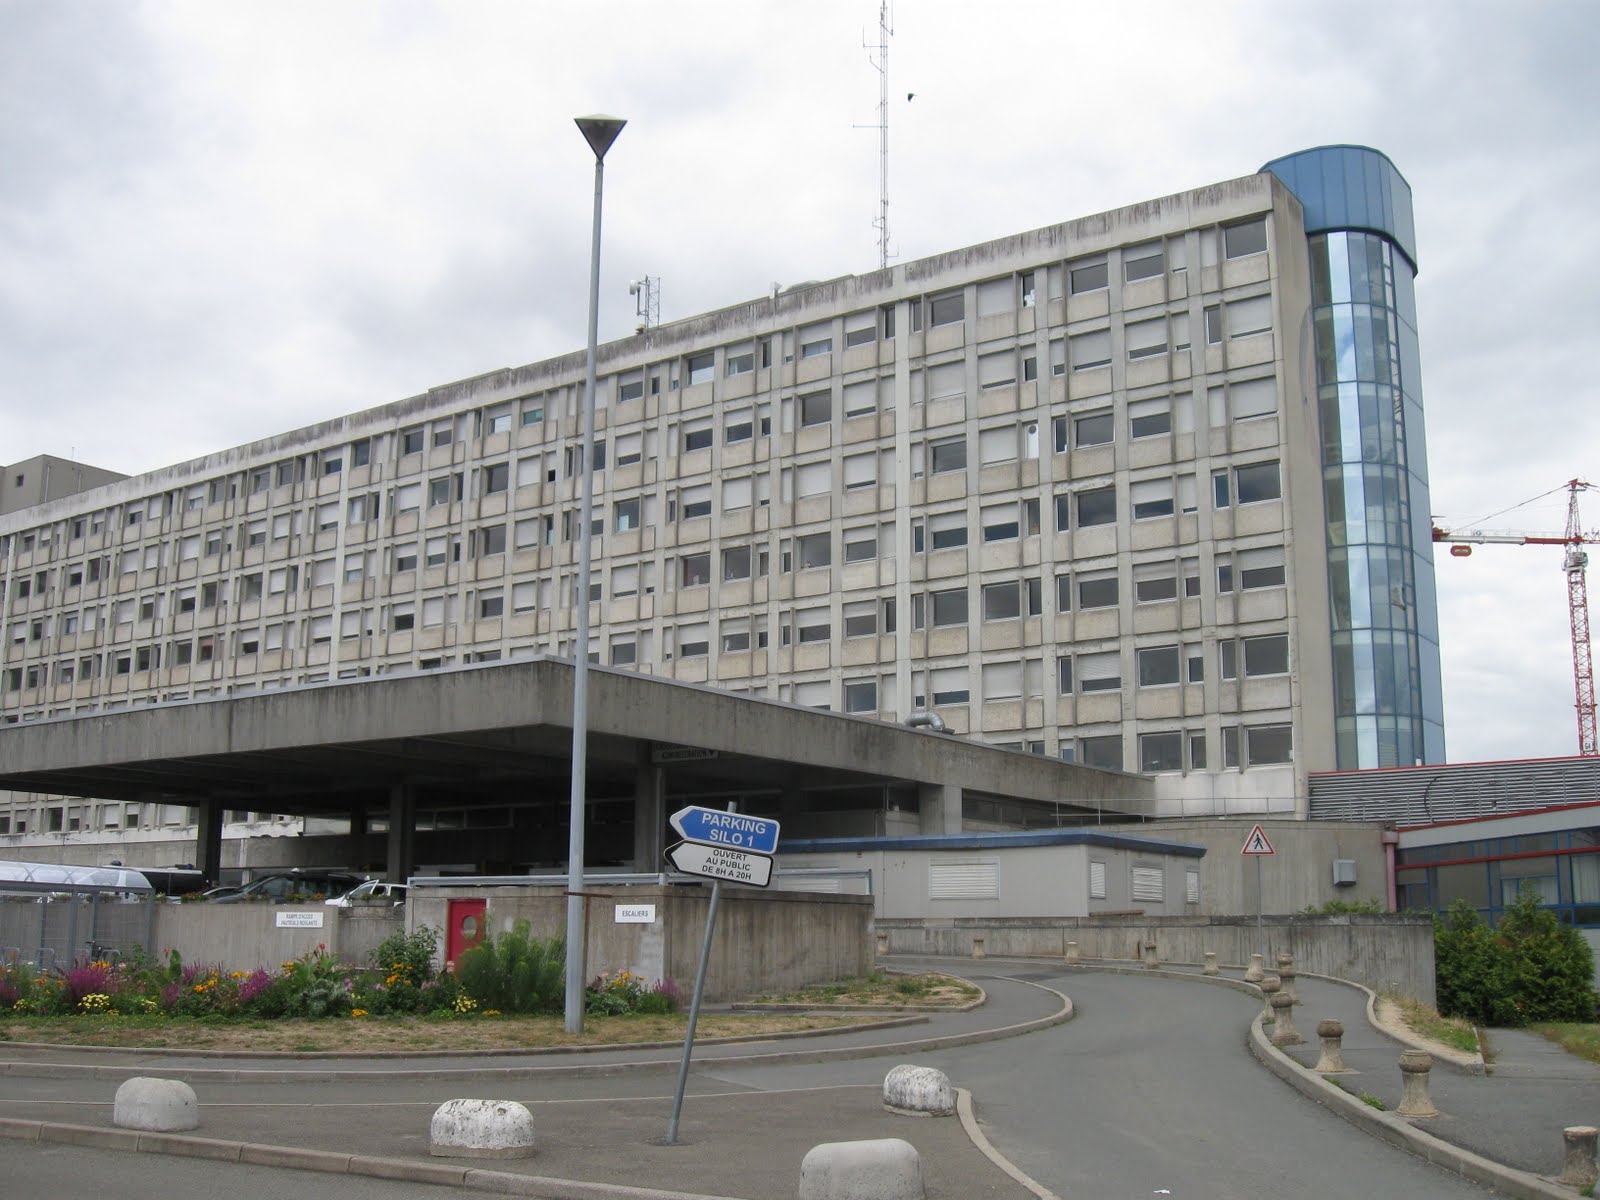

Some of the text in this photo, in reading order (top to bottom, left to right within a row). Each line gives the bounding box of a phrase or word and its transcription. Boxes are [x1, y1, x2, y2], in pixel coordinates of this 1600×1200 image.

[701, 812, 767, 834] PARKING
[709, 828, 754, 847] SILO 1
[713, 849, 747, 861] OUVERT
[705, 857, 751, 871] AU PUBLIC
[702, 865, 751, 880] DE 8H A 20H
